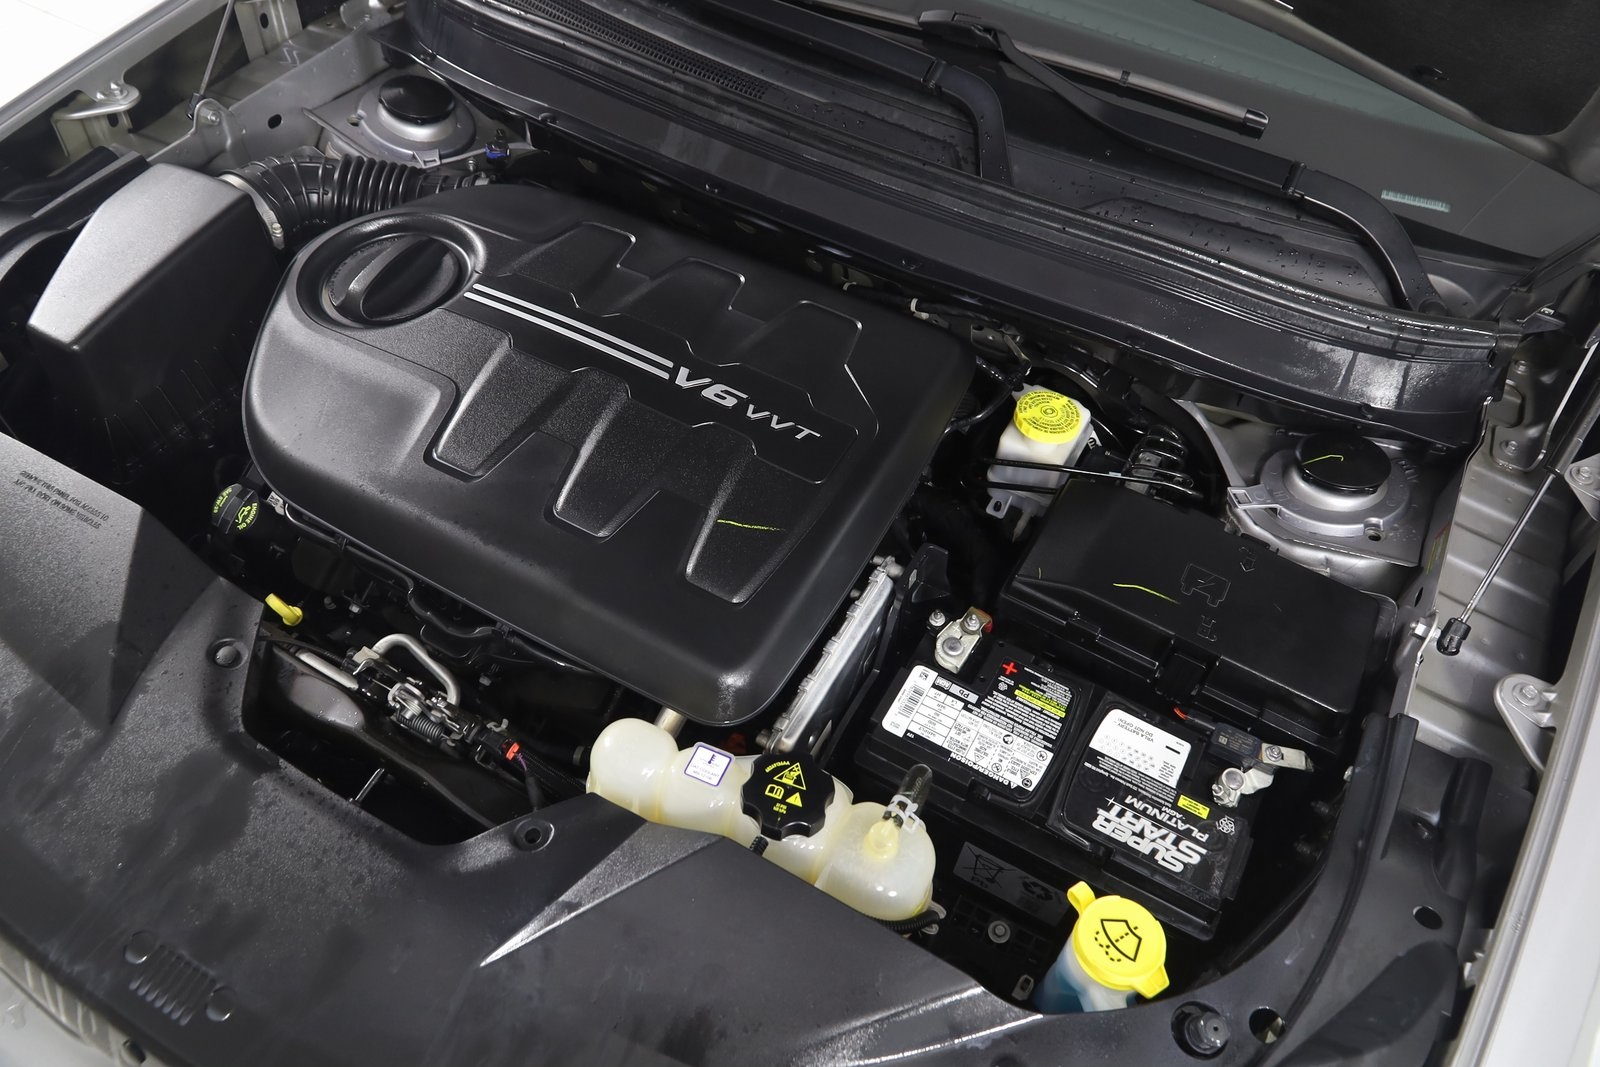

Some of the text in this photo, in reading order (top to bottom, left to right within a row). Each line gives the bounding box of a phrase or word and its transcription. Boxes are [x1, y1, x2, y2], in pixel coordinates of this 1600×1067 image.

[674, 366, 820, 439] V6 VVT
[237, 503, 257, 530] ENGINE OIL
[957, 688, 969, 698] Pb
[950, 753, 1009, 785] DANGER/POISON
[1122, 794, 1211, 842] PLATINUM
[1160, 805, 1183, 819] AGM
[1091, 813, 1184, 873] SUPER
[1096, 805, 1207, 864] START
